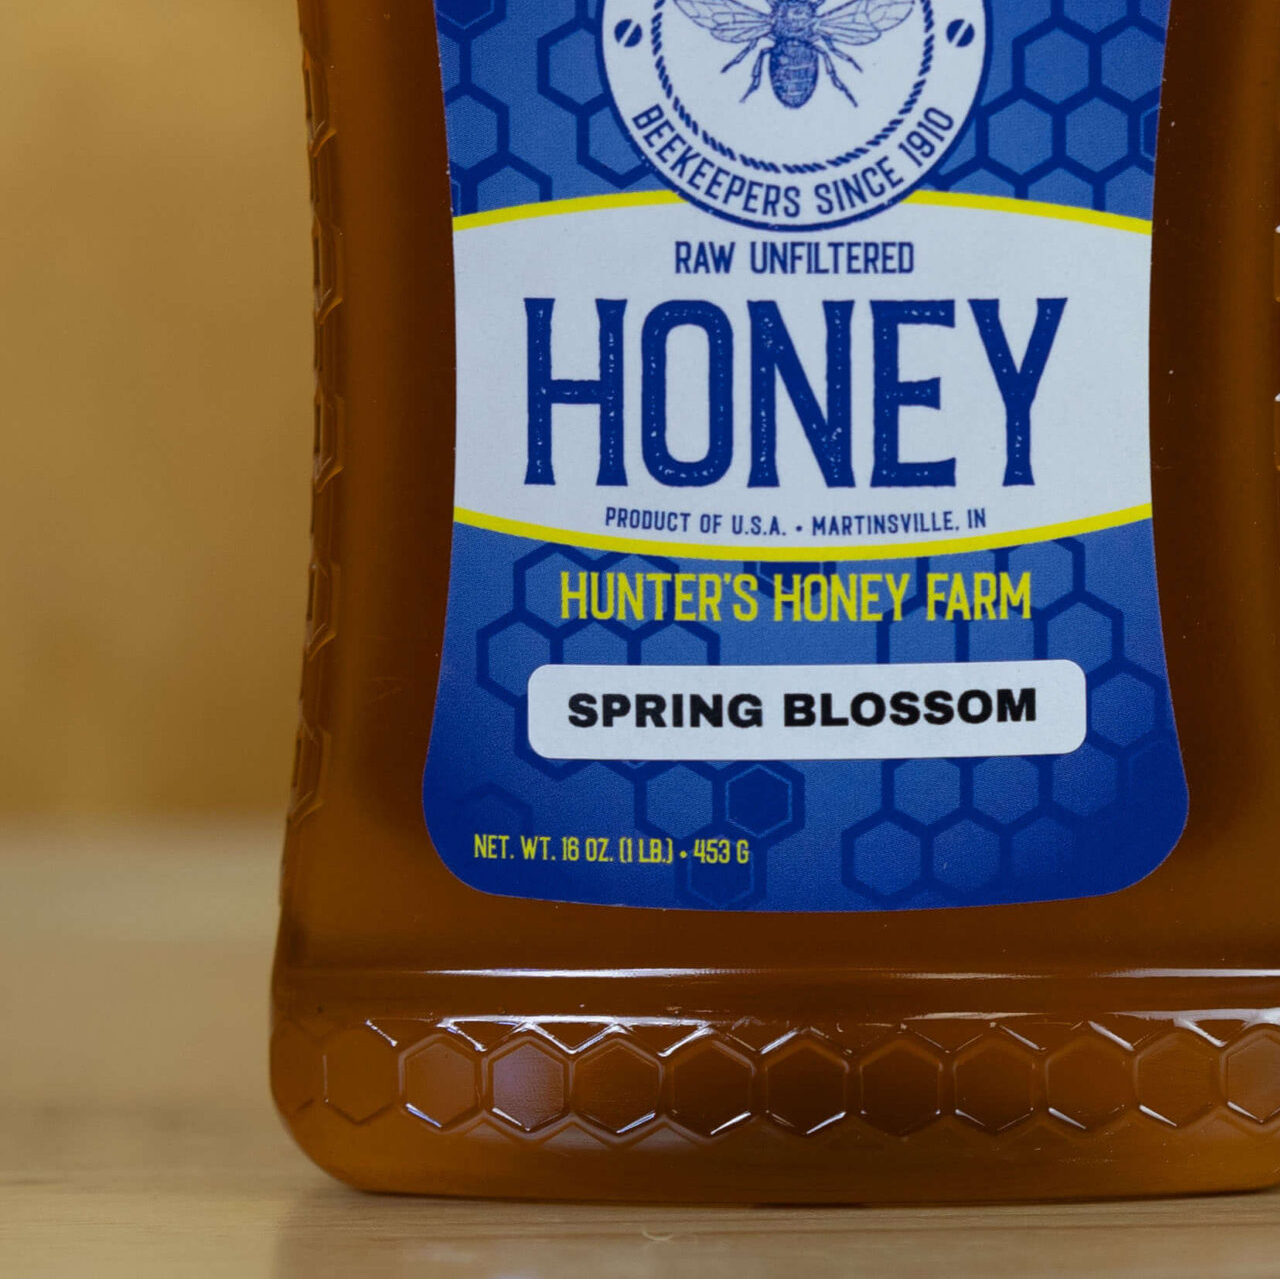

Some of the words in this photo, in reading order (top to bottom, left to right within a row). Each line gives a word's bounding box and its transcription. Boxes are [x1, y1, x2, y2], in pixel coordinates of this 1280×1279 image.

[632, 104, 801, 217] BEEKEEPERS
[816, 155, 904, 216] SINCE
[898, 105, 955, 169] 1910
[674, 241, 736, 274] RAW
[749, 241, 915, 274] UNFILTERED
[523, 297, 1069, 489] HONEY
[605, 506, 691, 532] PRODUCT
[699, 513, 723, 534] OF
[731, 514, 787, 536] U.S.A.
[967, 507, 987, 529] IN
[559, 571, 759, 621] HUNTER'S
[773, 572, 911, 622] HONEY
[925, 571, 1032, 621] FARM
[567, 691, 764, 729] SPRING
[782, 688, 1038, 728] BLOSSOM
[474, 833, 515, 860] NET.
[520, 835, 556, 861] WT.
[562, 836, 580, 861] 16
[585, 837, 614, 862] OZ.
[693, 839, 731, 864] 453
[736, 839, 749, 864] G
